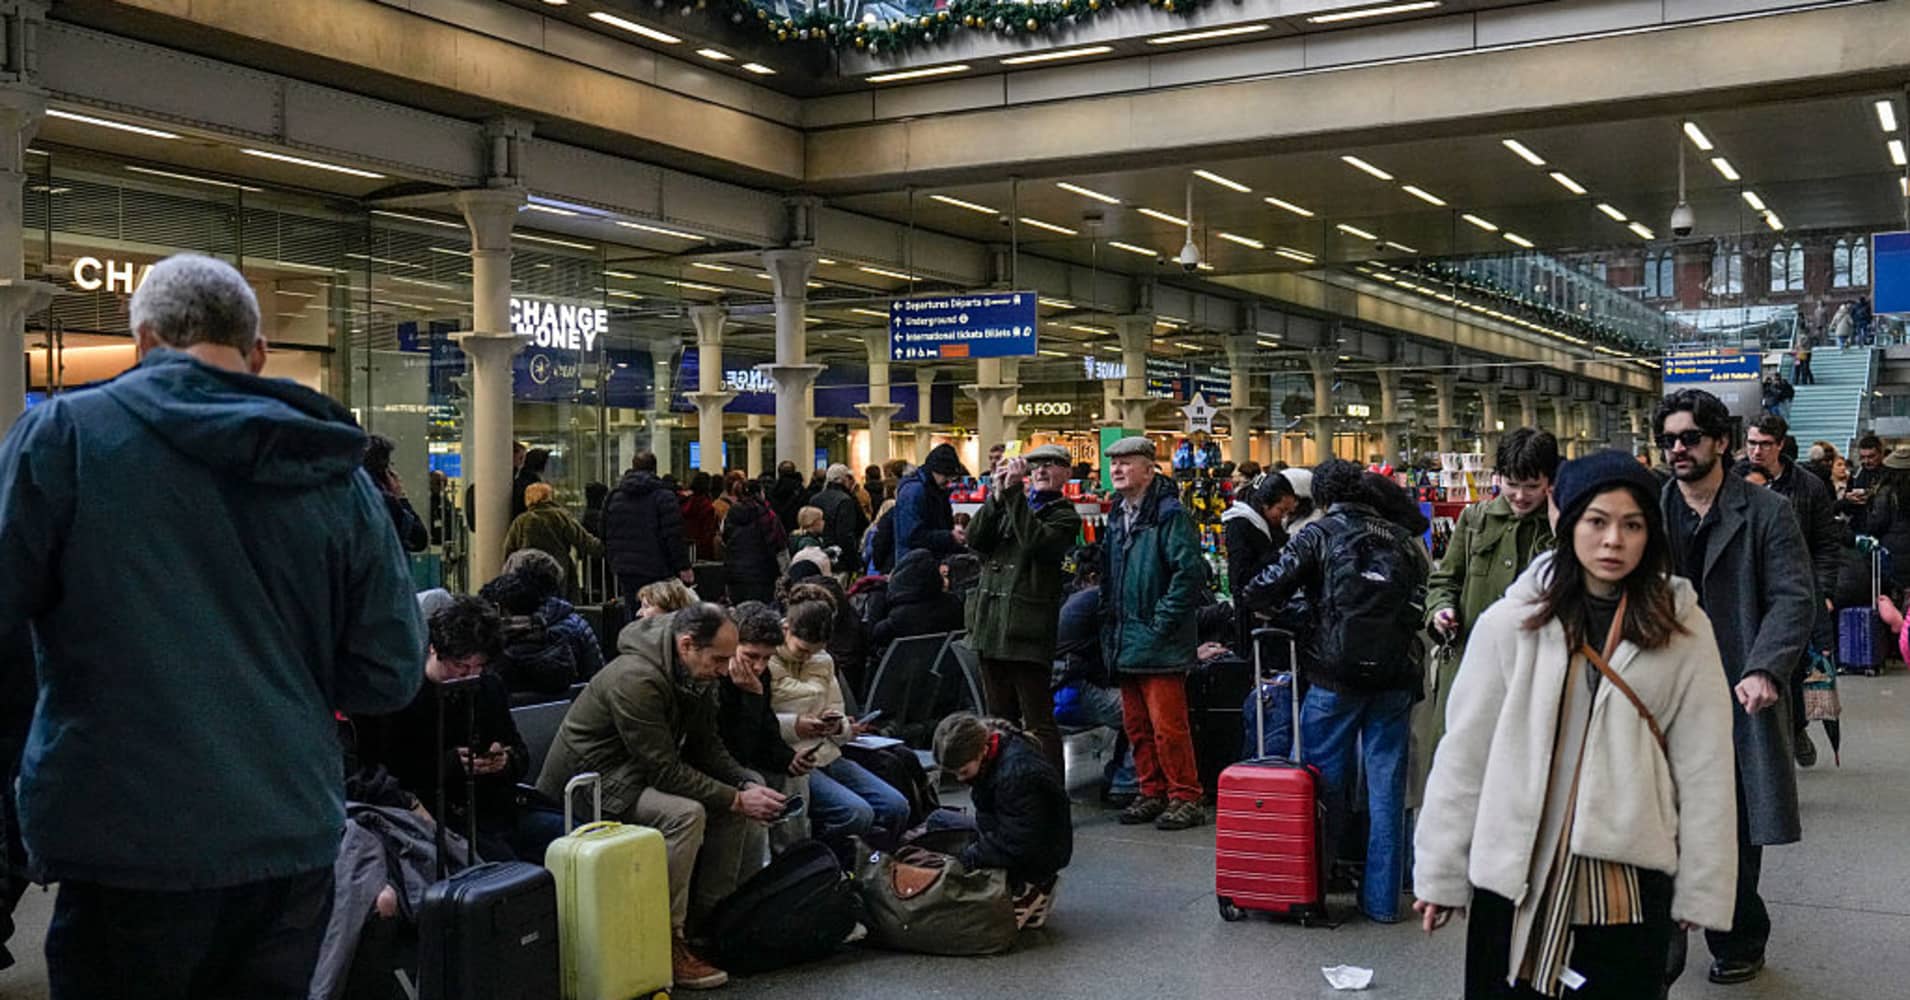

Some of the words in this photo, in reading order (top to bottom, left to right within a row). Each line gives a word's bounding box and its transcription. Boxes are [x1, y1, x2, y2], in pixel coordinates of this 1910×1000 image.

[905, 301, 949, 312] Departures
[510, 298, 608, 333] CHANGE
[905, 315, 957, 326] Underground
[905, 331, 955, 342] International
[1035, 402, 1072, 416] FOOD
